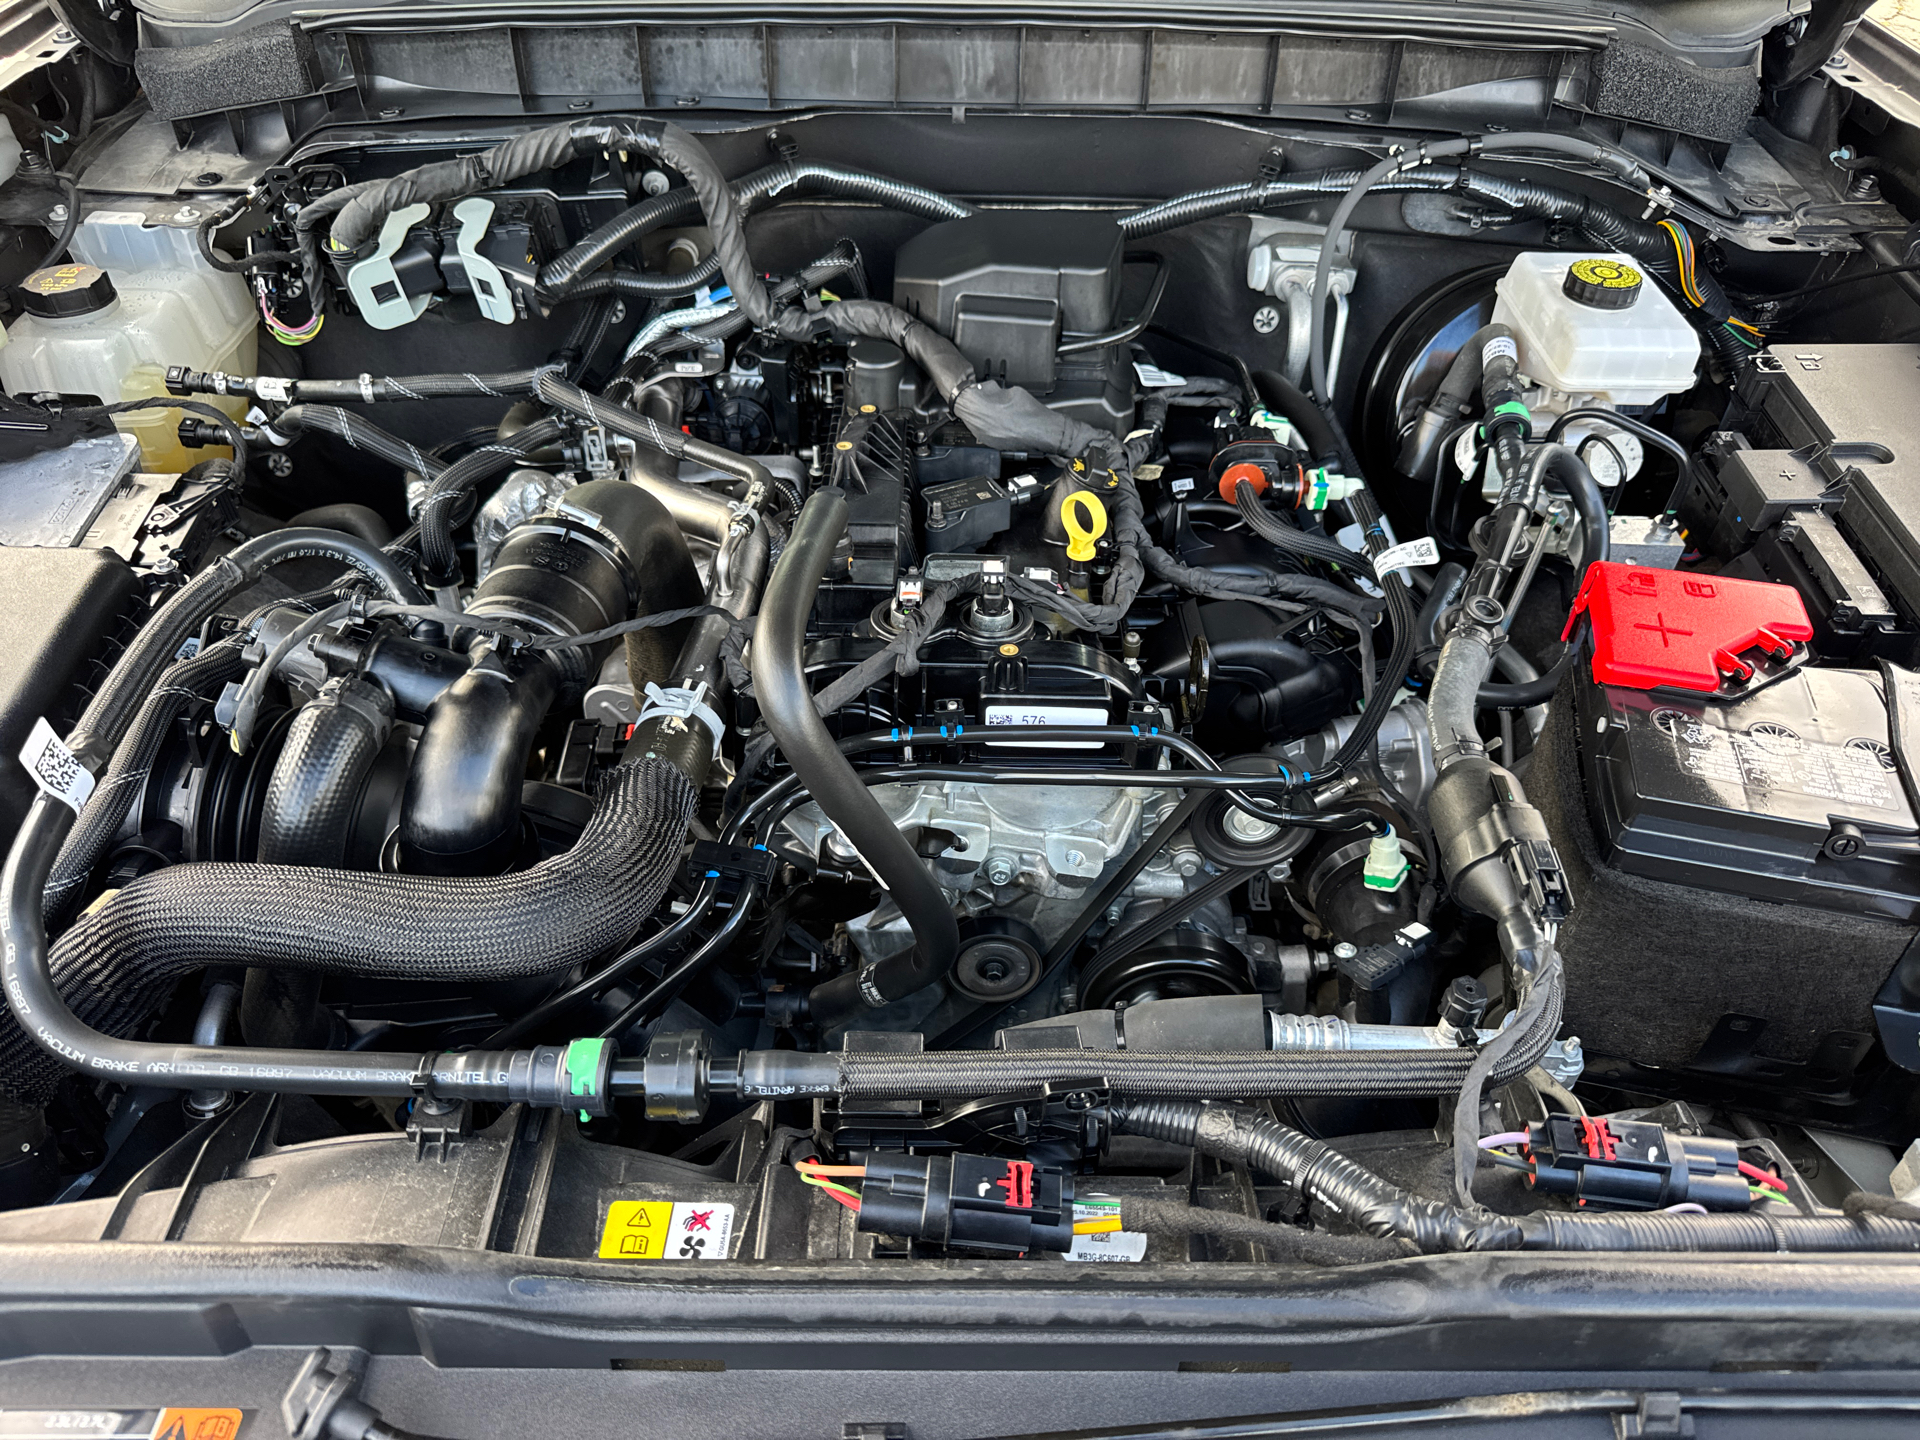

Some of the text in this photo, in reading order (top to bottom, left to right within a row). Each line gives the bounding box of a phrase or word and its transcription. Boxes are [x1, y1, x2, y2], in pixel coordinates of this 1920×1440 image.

[1021, 715, 1046, 725] 576
[5, 943, 16, 964] GB
[8, 973, 32, 1016] 16897
[37, 1026, 86, 1064] VACUUM
[91, 1056, 139, 1073] BRAKE
[219, 1065, 239, 1077] GB
[249, 1067, 293, 1078] 16897
[312, 1068, 367, 1081] VACUUM
[432, 1071, 490, 1084] ARNITEL
[755, 1085, 796, 1096] ARNITEL
